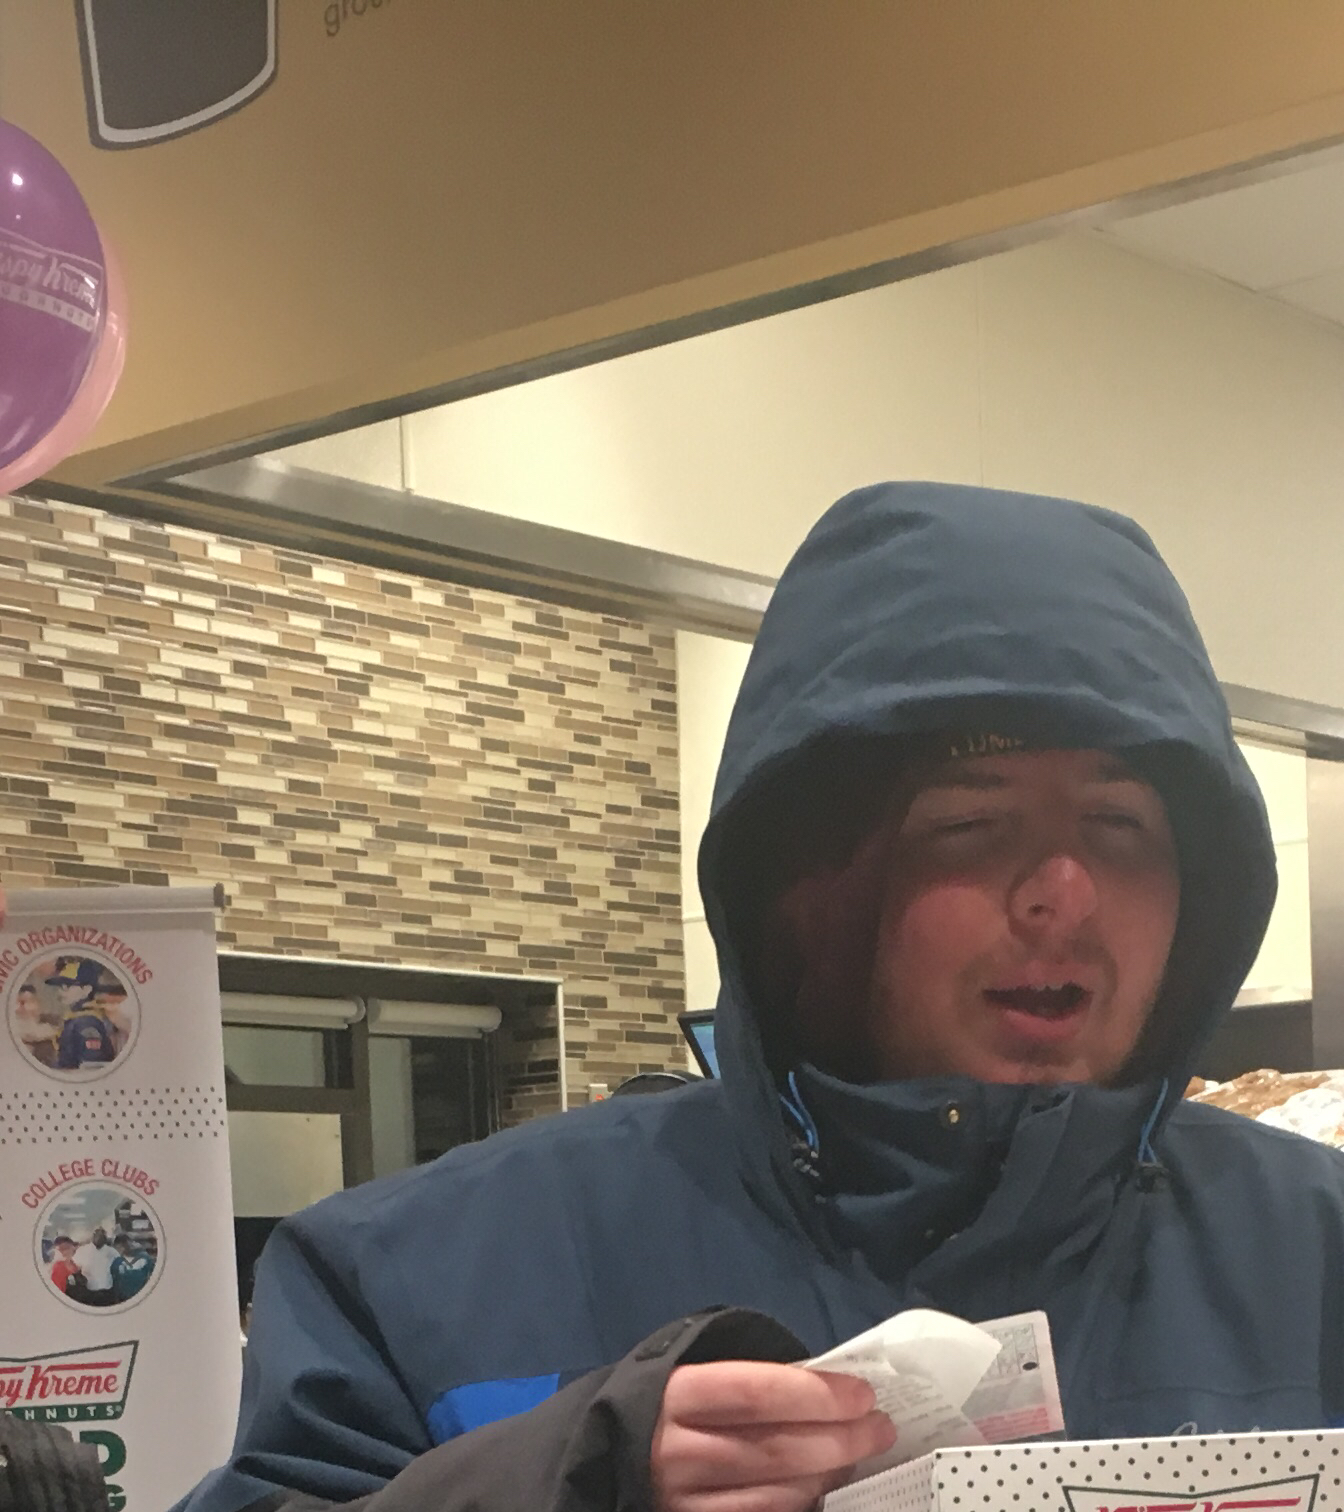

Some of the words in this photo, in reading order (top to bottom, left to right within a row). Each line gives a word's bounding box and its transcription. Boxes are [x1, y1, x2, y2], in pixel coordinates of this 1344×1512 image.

[16, 925, 154, 985] ORGANIZATIONS
[21, 1158, 96, 1209] COLLEGE
[101, 1158, 160, 1196] CLUBS
[25, 1360, 123, 1401] Kreme
